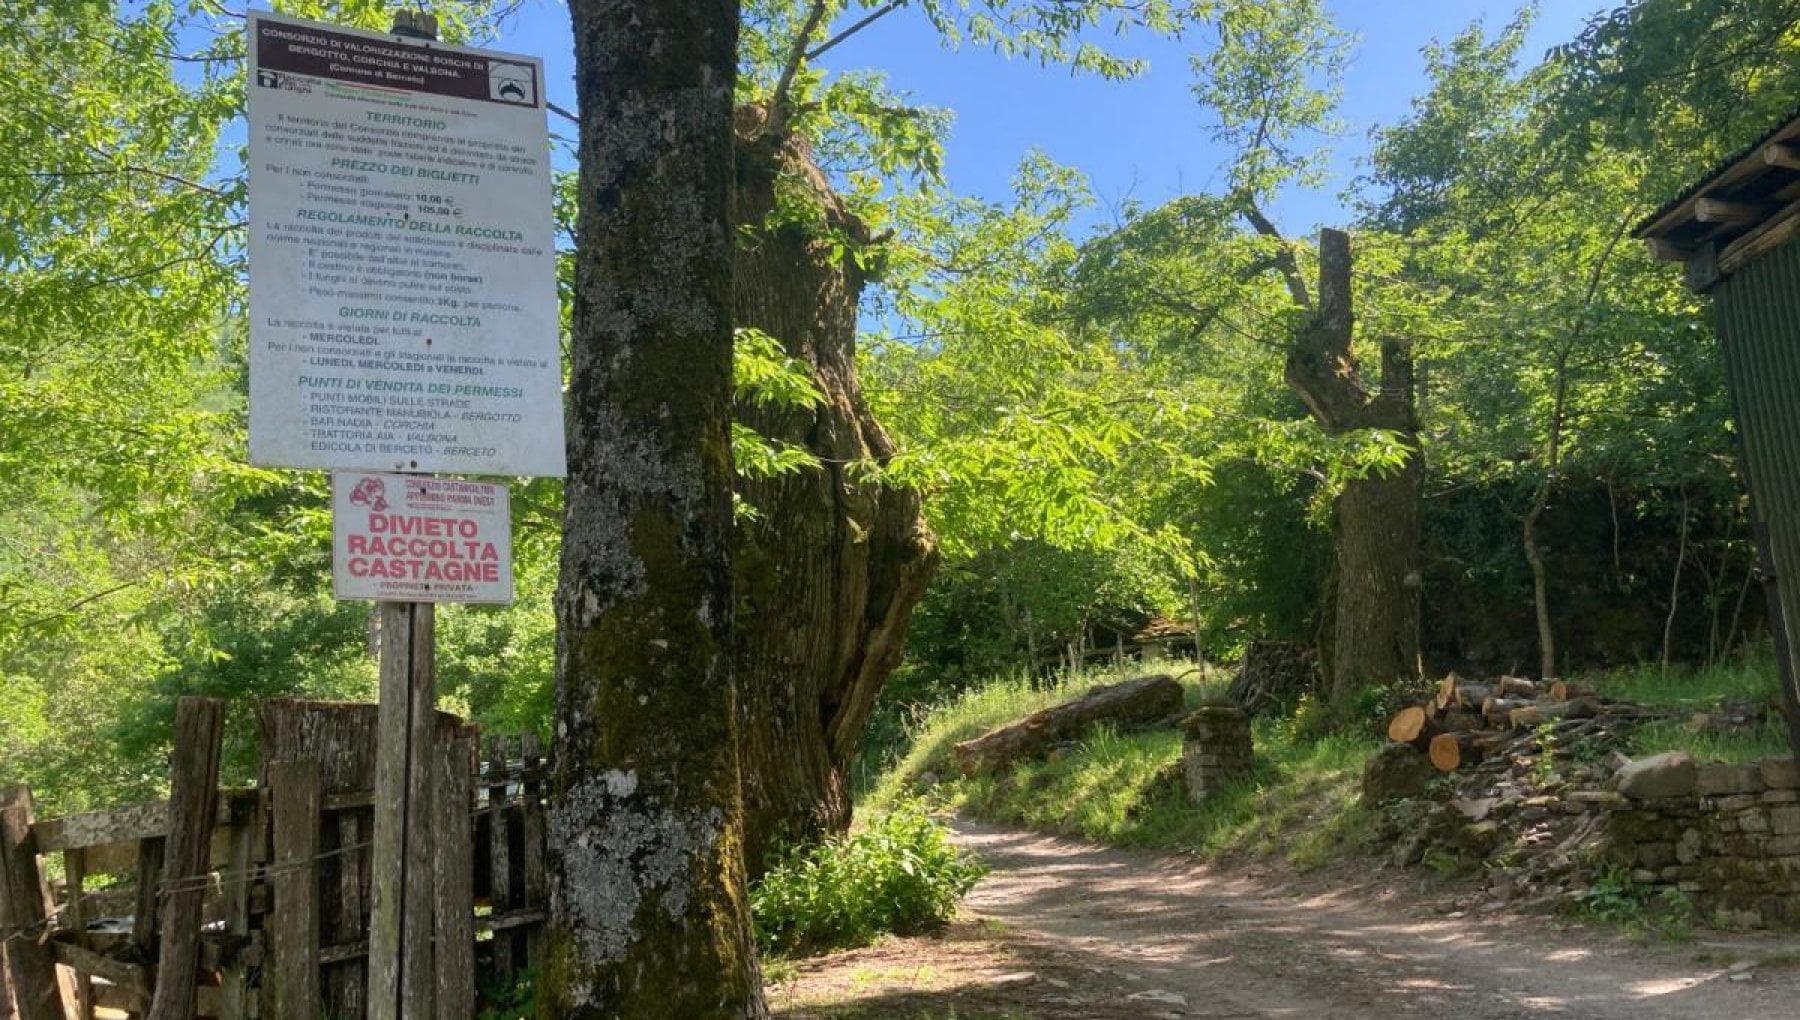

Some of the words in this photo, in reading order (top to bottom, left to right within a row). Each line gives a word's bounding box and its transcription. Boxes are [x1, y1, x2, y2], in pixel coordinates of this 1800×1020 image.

[262, 28, 327, 45] CONSORZIO
[330, 39, 341, 47] DI
[345, 41, 430, 62] VALORIZZAZIONE
[434, 55, 469, 68] BOSCHI
[474, 62, 484, 70] DI
[354, 54, 400, 69] CORCHIA
[367, 111, 447, 131] TERRITORIO
[332, 157, 387, 173] PREZZO
[391, 165, 413, 177] DEI
[417, 168, 480, 185] BIGLIETTI
[298, 209, 405, 229] REGOLAMENTO
[409, 220, 450, 234] DELLA
[456, 225, 523, 241] RACCOLTA
[339, 307, 388, 320] GIORNI
[392, 311, 406, 321] DI
[411, 312, 481, 327] RACCOLTA
[358, 360, 424, 372] MERCOLEDI
[298, 376, 342, 388] PUNTI
[346, 379, 360, 389] DI
[366, 380, 423, 392] VENDITA
[428, 383, 451, 394] DEI
[455, 384, 523, 398] PERMESSI
[310, 392, 345, 402] PUNTI
[348, 394, 386, 404] MOBILI
[390, 396, 424, 406] SULLE
[427, 398, 470, 408] STRADE
[311, 405, 384, 416] RISTORANTE
[311, 417, 334, 426] BAR
[337, 418, 372, 427] NADIA
[311, 429, 373, 439] TRATTORIA
[377, 432, 394, 440] AIA
[311, 442, 361, 452] EDICOLA
[366, 444, 376, 452] DI
[380, 444, 432, 454] BERCETO
[369, 514, 478, 538] DIVIETO
[348, 535, 499, 561] RACCOLTA
[348, 558, 499, 582] CASTAGNE
[434, 584, 474, 592] PRIVATA
